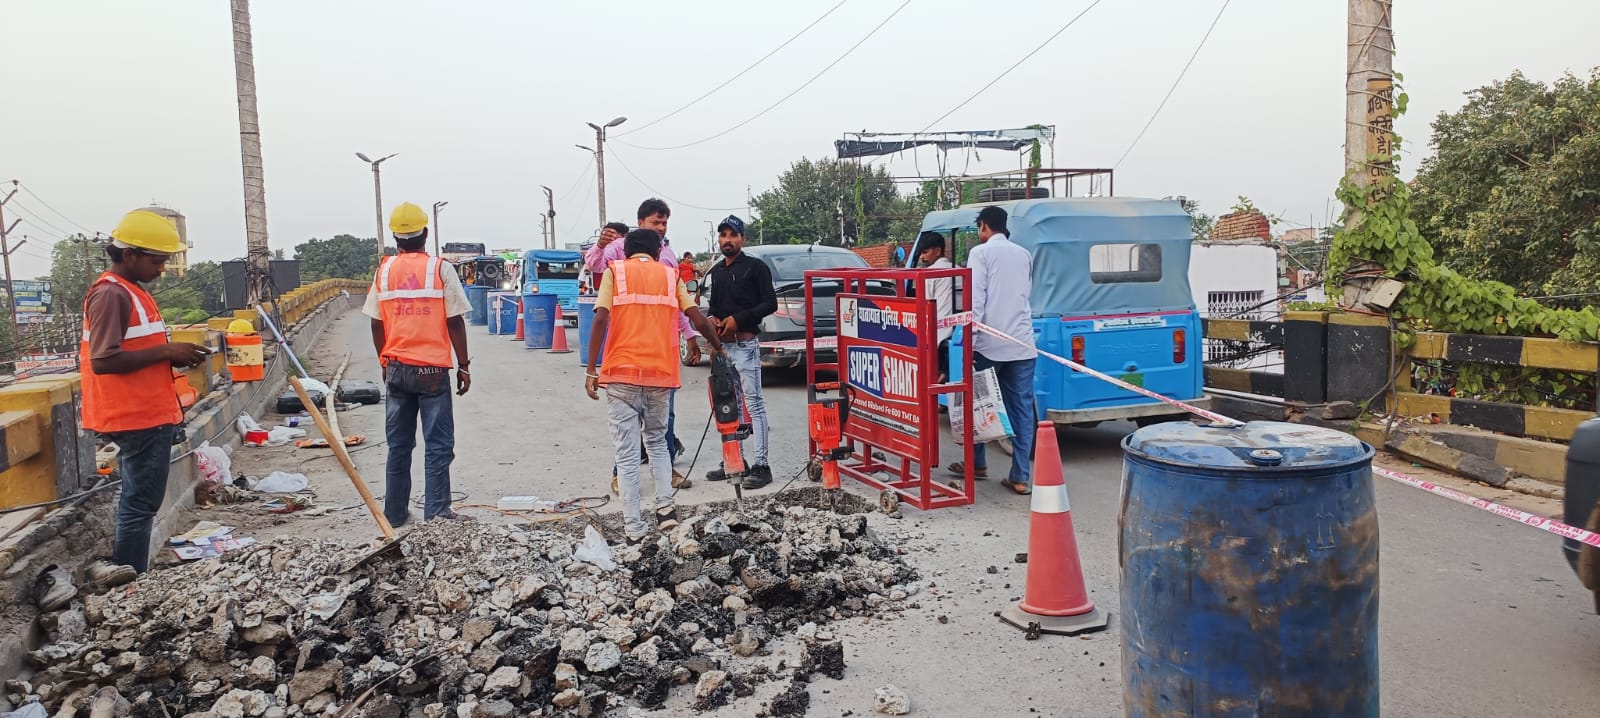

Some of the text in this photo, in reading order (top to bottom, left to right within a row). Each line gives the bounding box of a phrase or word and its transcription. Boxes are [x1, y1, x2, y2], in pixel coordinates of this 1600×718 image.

[393, 304, 432, 317] didas
[850, 350, 880, 391] SUPER
[883, 355, 918, 399] SHAKT
[867, 400, 885, 412] Ribbed
[891, 407, 901, 418] 600
[901, 410, 913, 422] TMT
